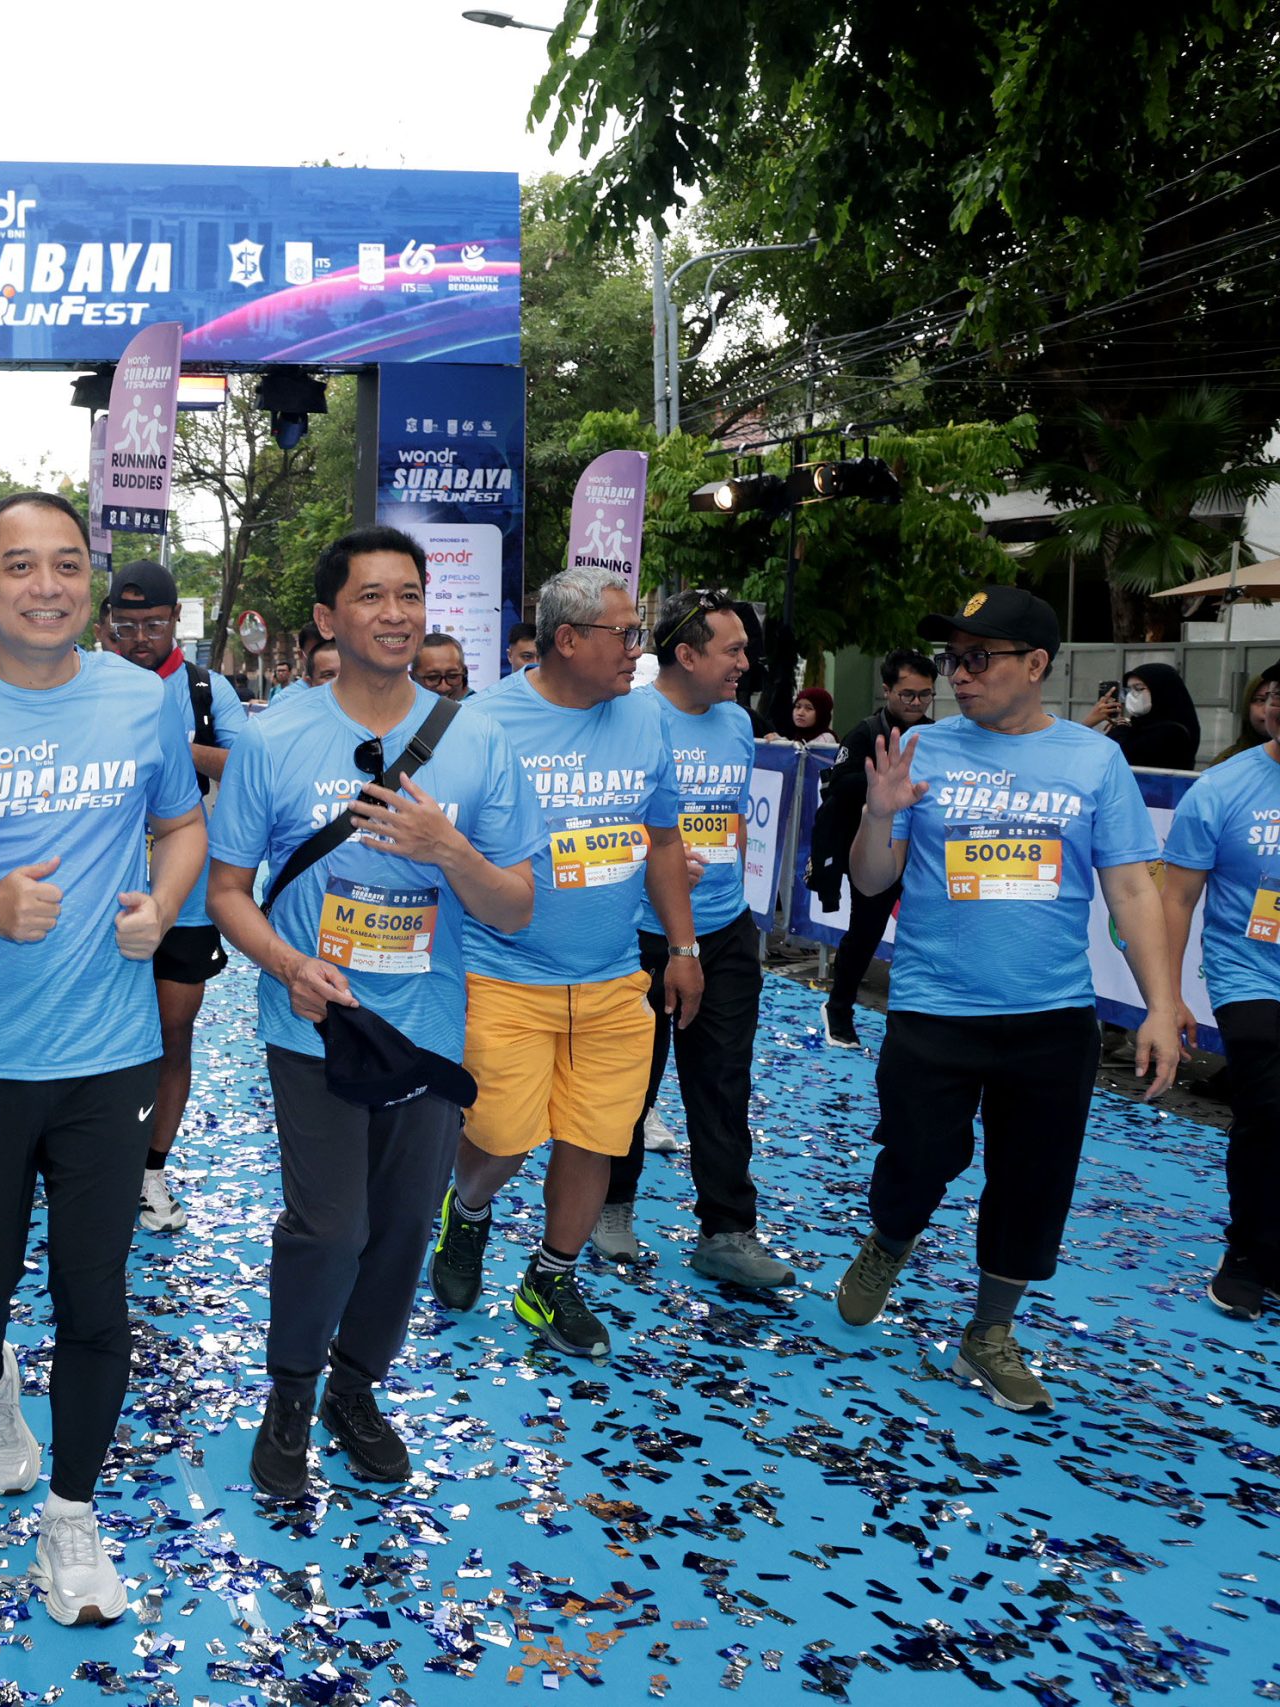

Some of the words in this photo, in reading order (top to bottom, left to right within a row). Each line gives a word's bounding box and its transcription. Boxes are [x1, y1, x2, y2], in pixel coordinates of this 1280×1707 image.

[7, 230, 25, 238] BNI
[315, 258, 331, 268] ITS
[401, 283, 416, 293] ITS
[448, 284, 499, 292] BERDAMPAK
[124, 366, 172, 381] SURABAYA
[111, 453, 166, 469] RUNNING
[398, 447, 458, 463] wondr
[112, 473, 163, 490] BUDDIES
[393, 468, 512, 489] SURABAYA
[585, 486, 635, 499] SURABAYA
[426, 550, 472, 563] wondr
[575, 556, 632, 574] RUNNING
[520, 751, 586, 769] wondr
[672, 747, 707, 761] ondr
[527, 770, 646, 794] URABAYA
[676, 765, 746, 784] RABAY
[946, 770, 1016, 786] wondr
[314, 779, 365, 796] won
[937, 787, 1082, 816] SURABAYA
[683, 817, 727, 832] 50031
[557, 838, 576, 854] M
[585, 831, 643, 851] 50720
[965, 844, 1042, 862] 50048
[559, 871, 579, 883] 5K
[953, 882, 972, 894] 5K
[336, 905, 355, 924] M
[364, 913, 423, 931] 65086
[1253, 925, 1271, 936] 5K
[323, 941, 344, 958] 5K
